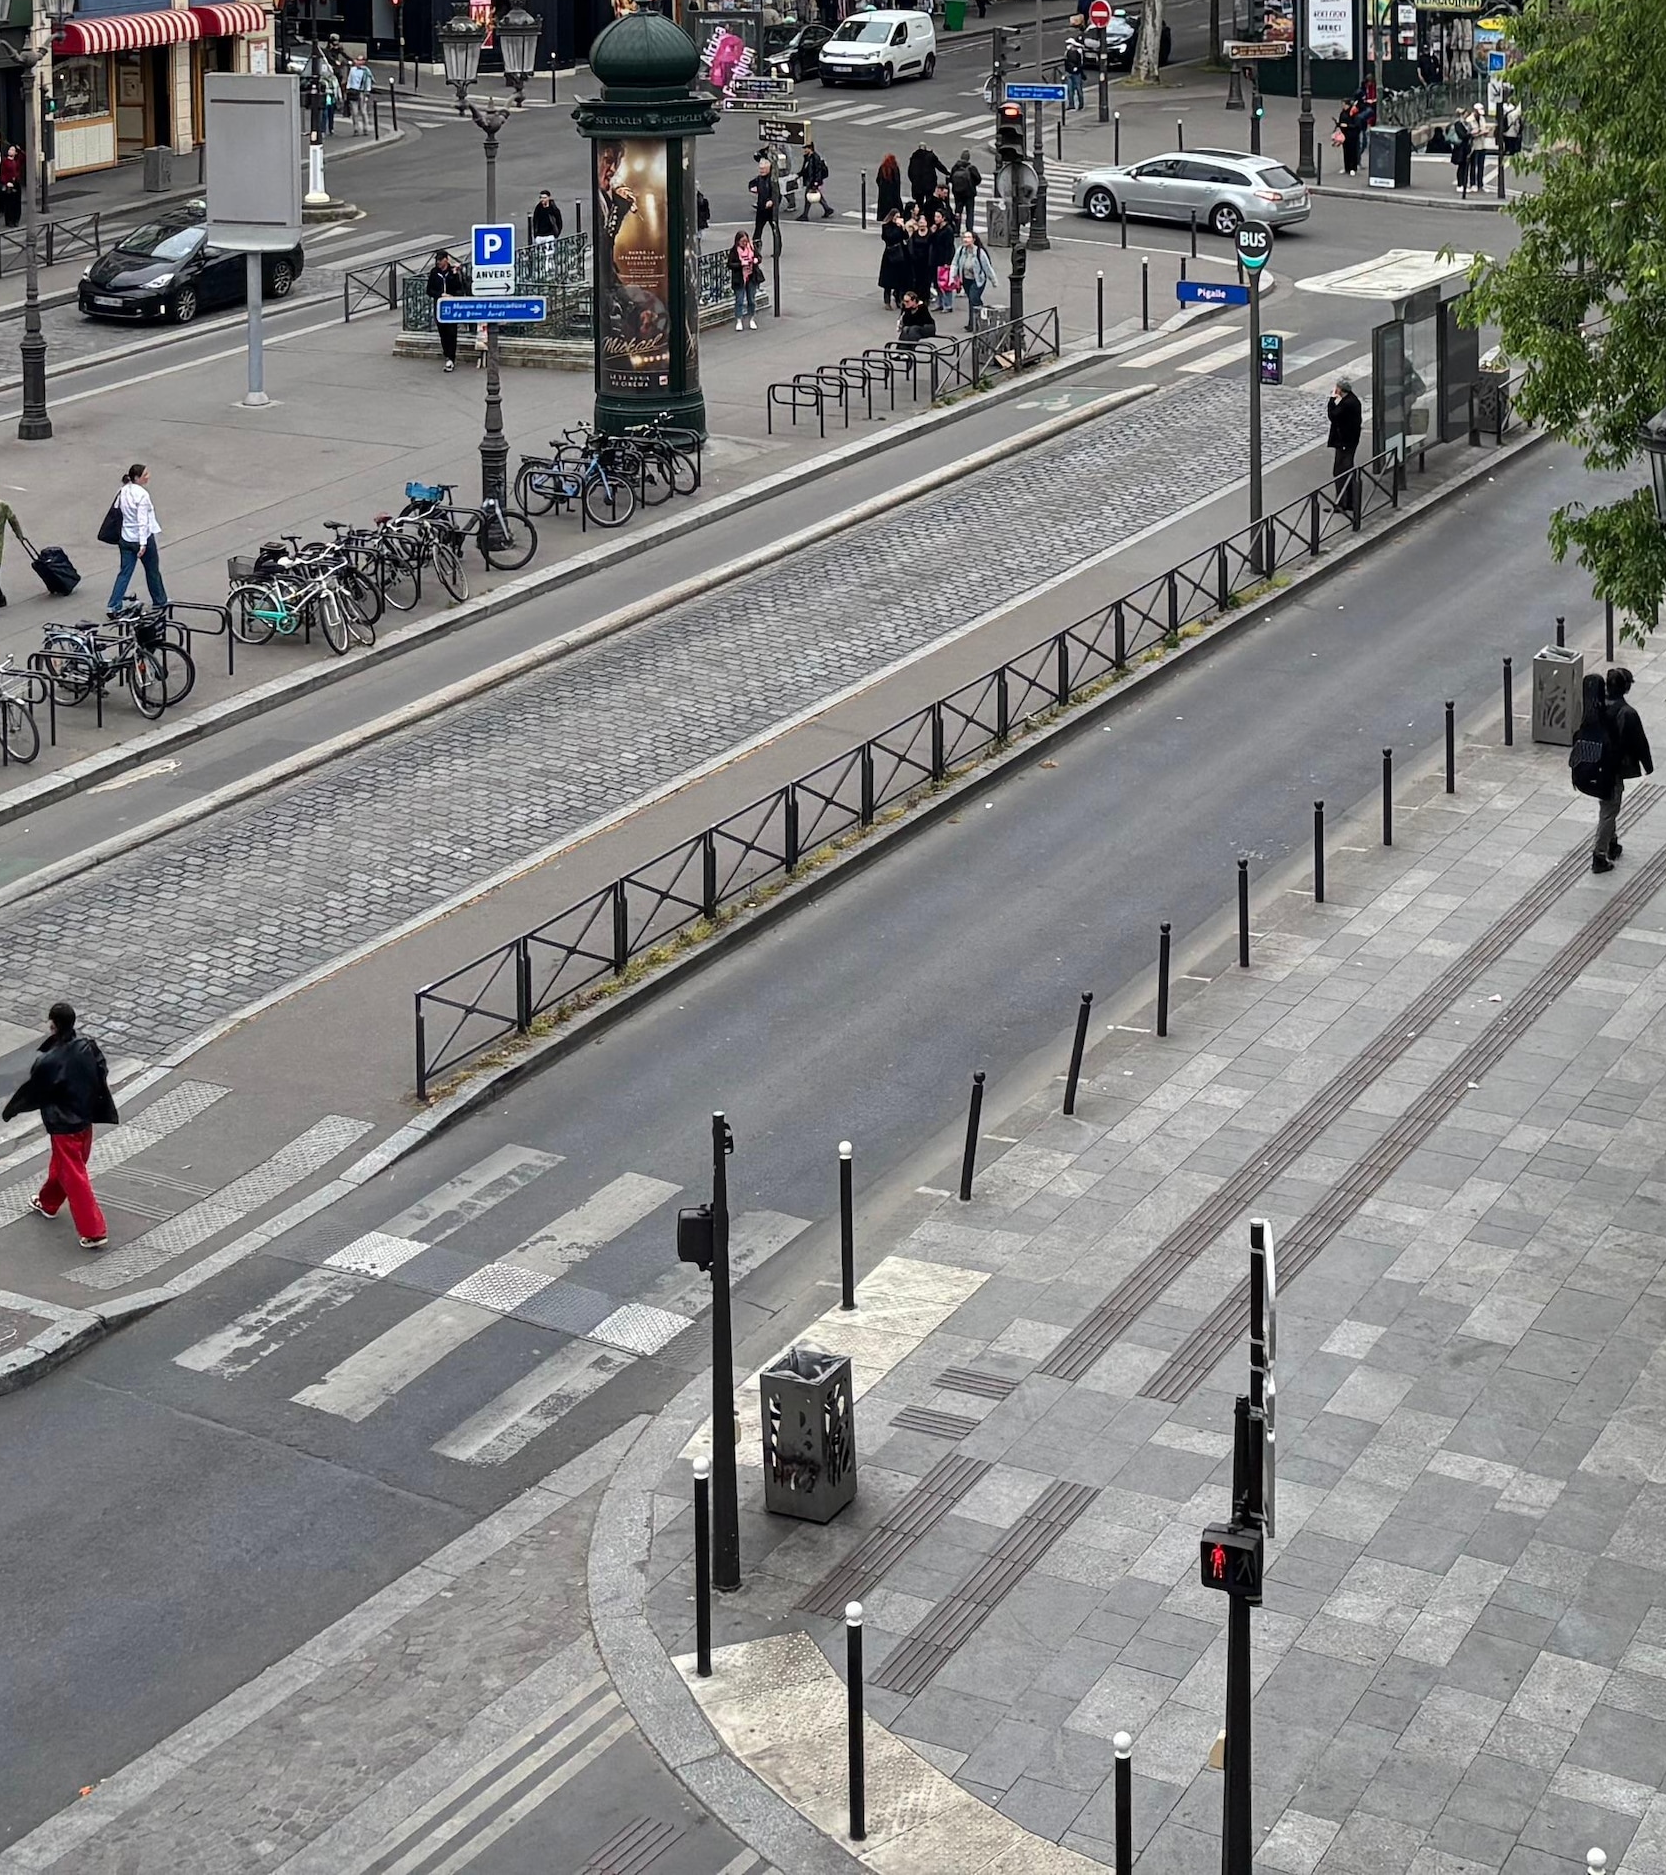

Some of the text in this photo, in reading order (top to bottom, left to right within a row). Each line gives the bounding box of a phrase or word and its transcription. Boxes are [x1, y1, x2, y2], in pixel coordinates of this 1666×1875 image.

[700, 25, 727, 67] Africa
[483, 233, 503, 260] P
[1239, 231, 1267, 248] BUS
[475, 269, 512, 280] ANVERS
[1197, 288, 1227, 299] Pigalle
[602, 333, 665, 355] Michael
[1263, 337, 1277, 348] 54
